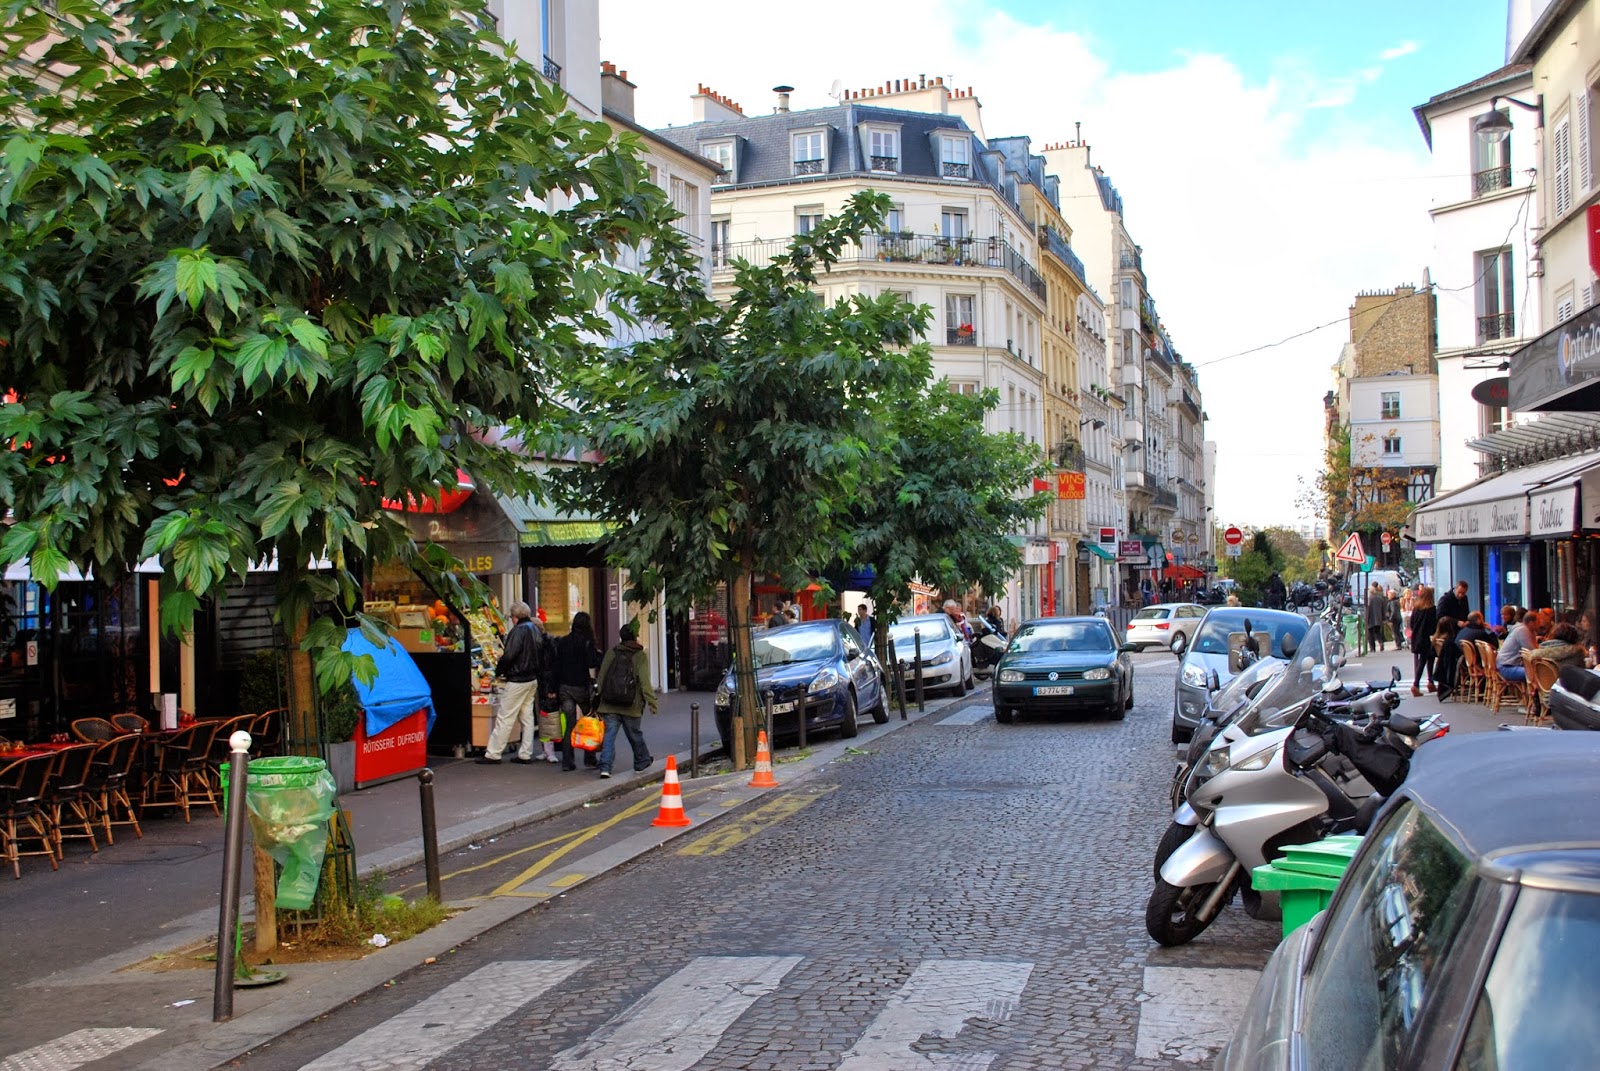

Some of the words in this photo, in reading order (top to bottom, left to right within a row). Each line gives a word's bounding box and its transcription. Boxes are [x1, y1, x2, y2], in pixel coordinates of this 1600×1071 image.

[1059, 474, 1084, 484] VINS
[1538, 497, 1563, 530] Tabac
[363, 737, 395, 753] RÔTISSERIE
